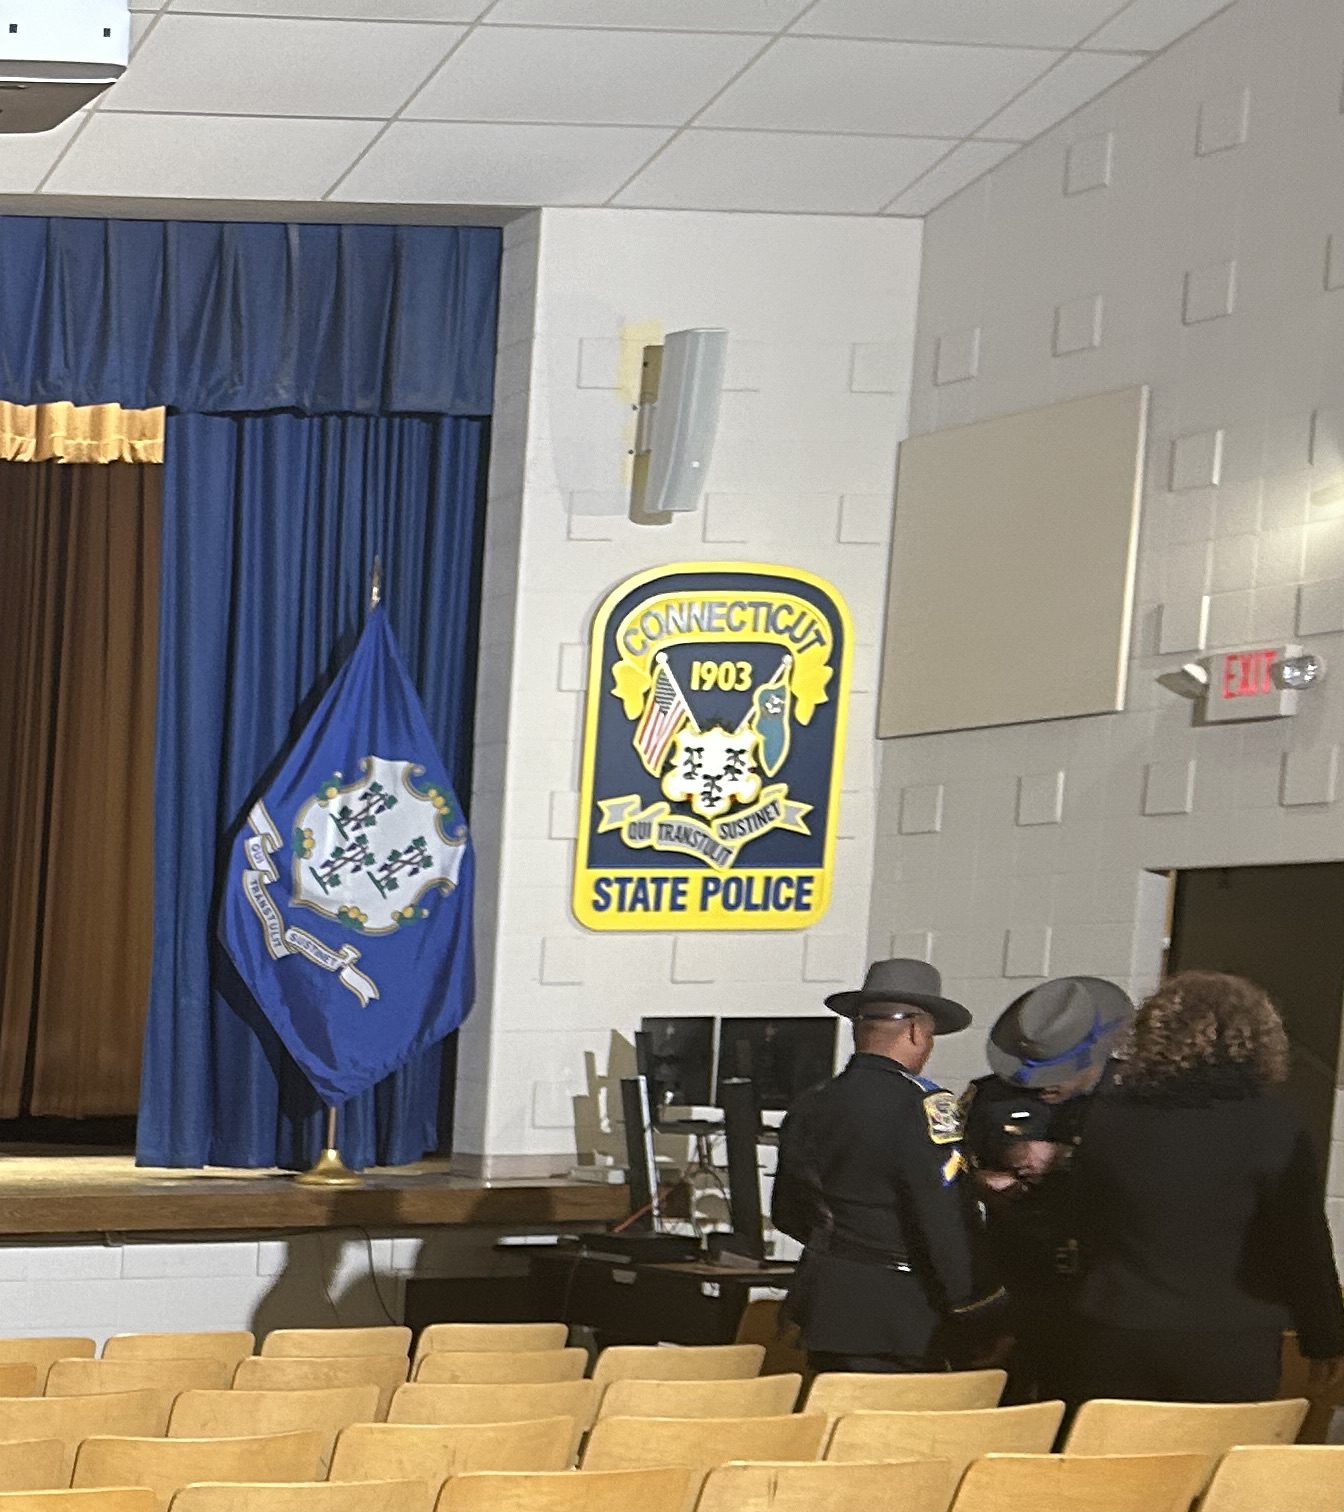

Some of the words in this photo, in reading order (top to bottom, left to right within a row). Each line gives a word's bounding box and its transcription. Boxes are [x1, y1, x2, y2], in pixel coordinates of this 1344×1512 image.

[623, 600, 826, 657] CONNECTICUT
[690, 661, 753, 692] 1903
[1223, 648, 1277, 699] EXIT
[719, 802, 781, 840] SUSTINET
[592, 876, 689, 912] STATE
[699, 875, 815, 912] POLICE
